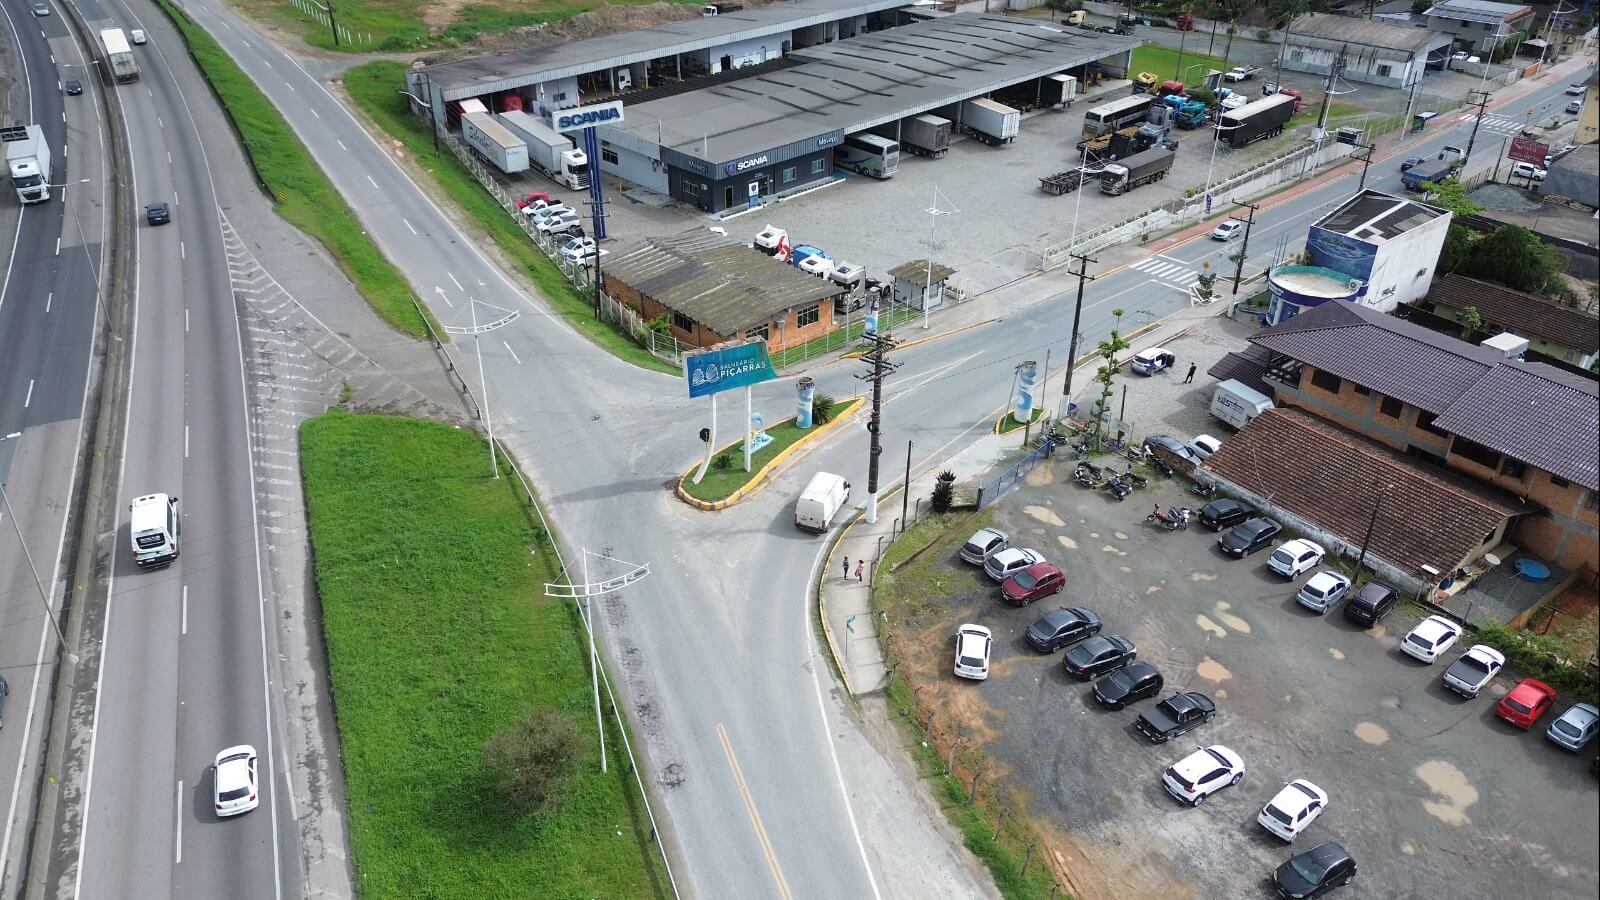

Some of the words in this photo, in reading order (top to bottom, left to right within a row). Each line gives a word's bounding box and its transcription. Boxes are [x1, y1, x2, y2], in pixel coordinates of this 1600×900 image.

[559, 107, 620, 128] SCANIA
[737, 155, 768, 170] SCANIA
[720, 361, 766, 378] PIÇARRAS
